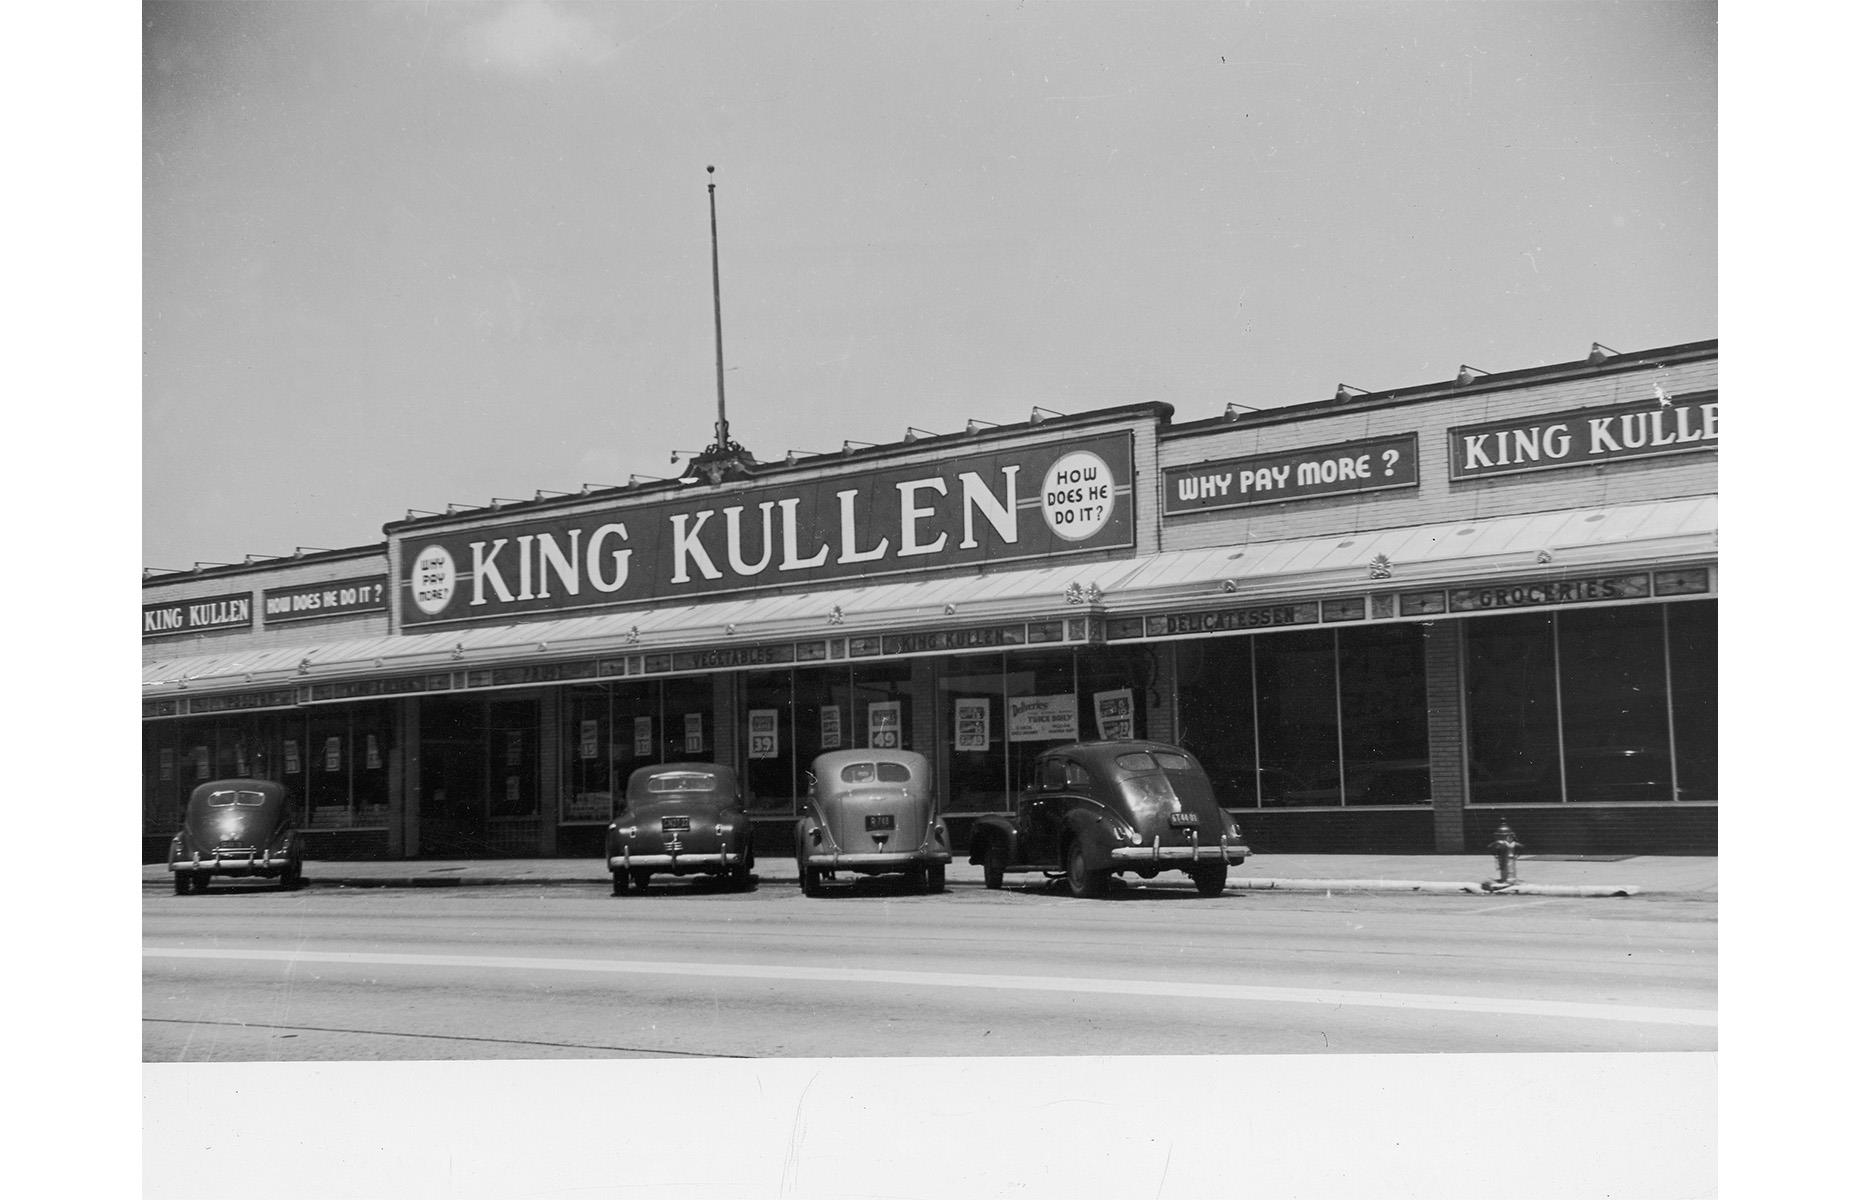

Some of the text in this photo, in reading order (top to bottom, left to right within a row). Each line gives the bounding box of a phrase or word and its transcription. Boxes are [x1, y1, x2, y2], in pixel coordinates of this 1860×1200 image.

[1463, 424, 1572, 470] KING
[1057, 467, 1097, 485] HOW
[1178, 473, 1233, 501] WHY
[1239, 465, 1291, 493] PAY
[1297, 455, 1372, 486] MORE
[1048, 485, 1108, 506] DOES HE
[1055, 509, 1075, 525] DO
[469, 465, 1022, 606] KING KULLEN
[420, 557, 446, 571] WHY
[422, 573, 446, 586] PAY
[266, 596, 291, 614] HOW
[293, 593, 321, 611] DOES
[323, 591, 338, 607] HE
[340, 588, 357, 605] DO
[359, 586, 371, 603] IT
[418, 588, 450, 602] MORE?
[1480, 580, 1616, 607] GROCERIES
[144, 599, 249, 631] KING KULLEN
[1166, 607, 1295, 633] DELICATESSEN
[901, 629, 1004, 651] KING KULLEN
[693, 648, 773, 668] VEGETABLES
[753, 737, 772, 752] 39
[873, 732, 896, 748] 49
